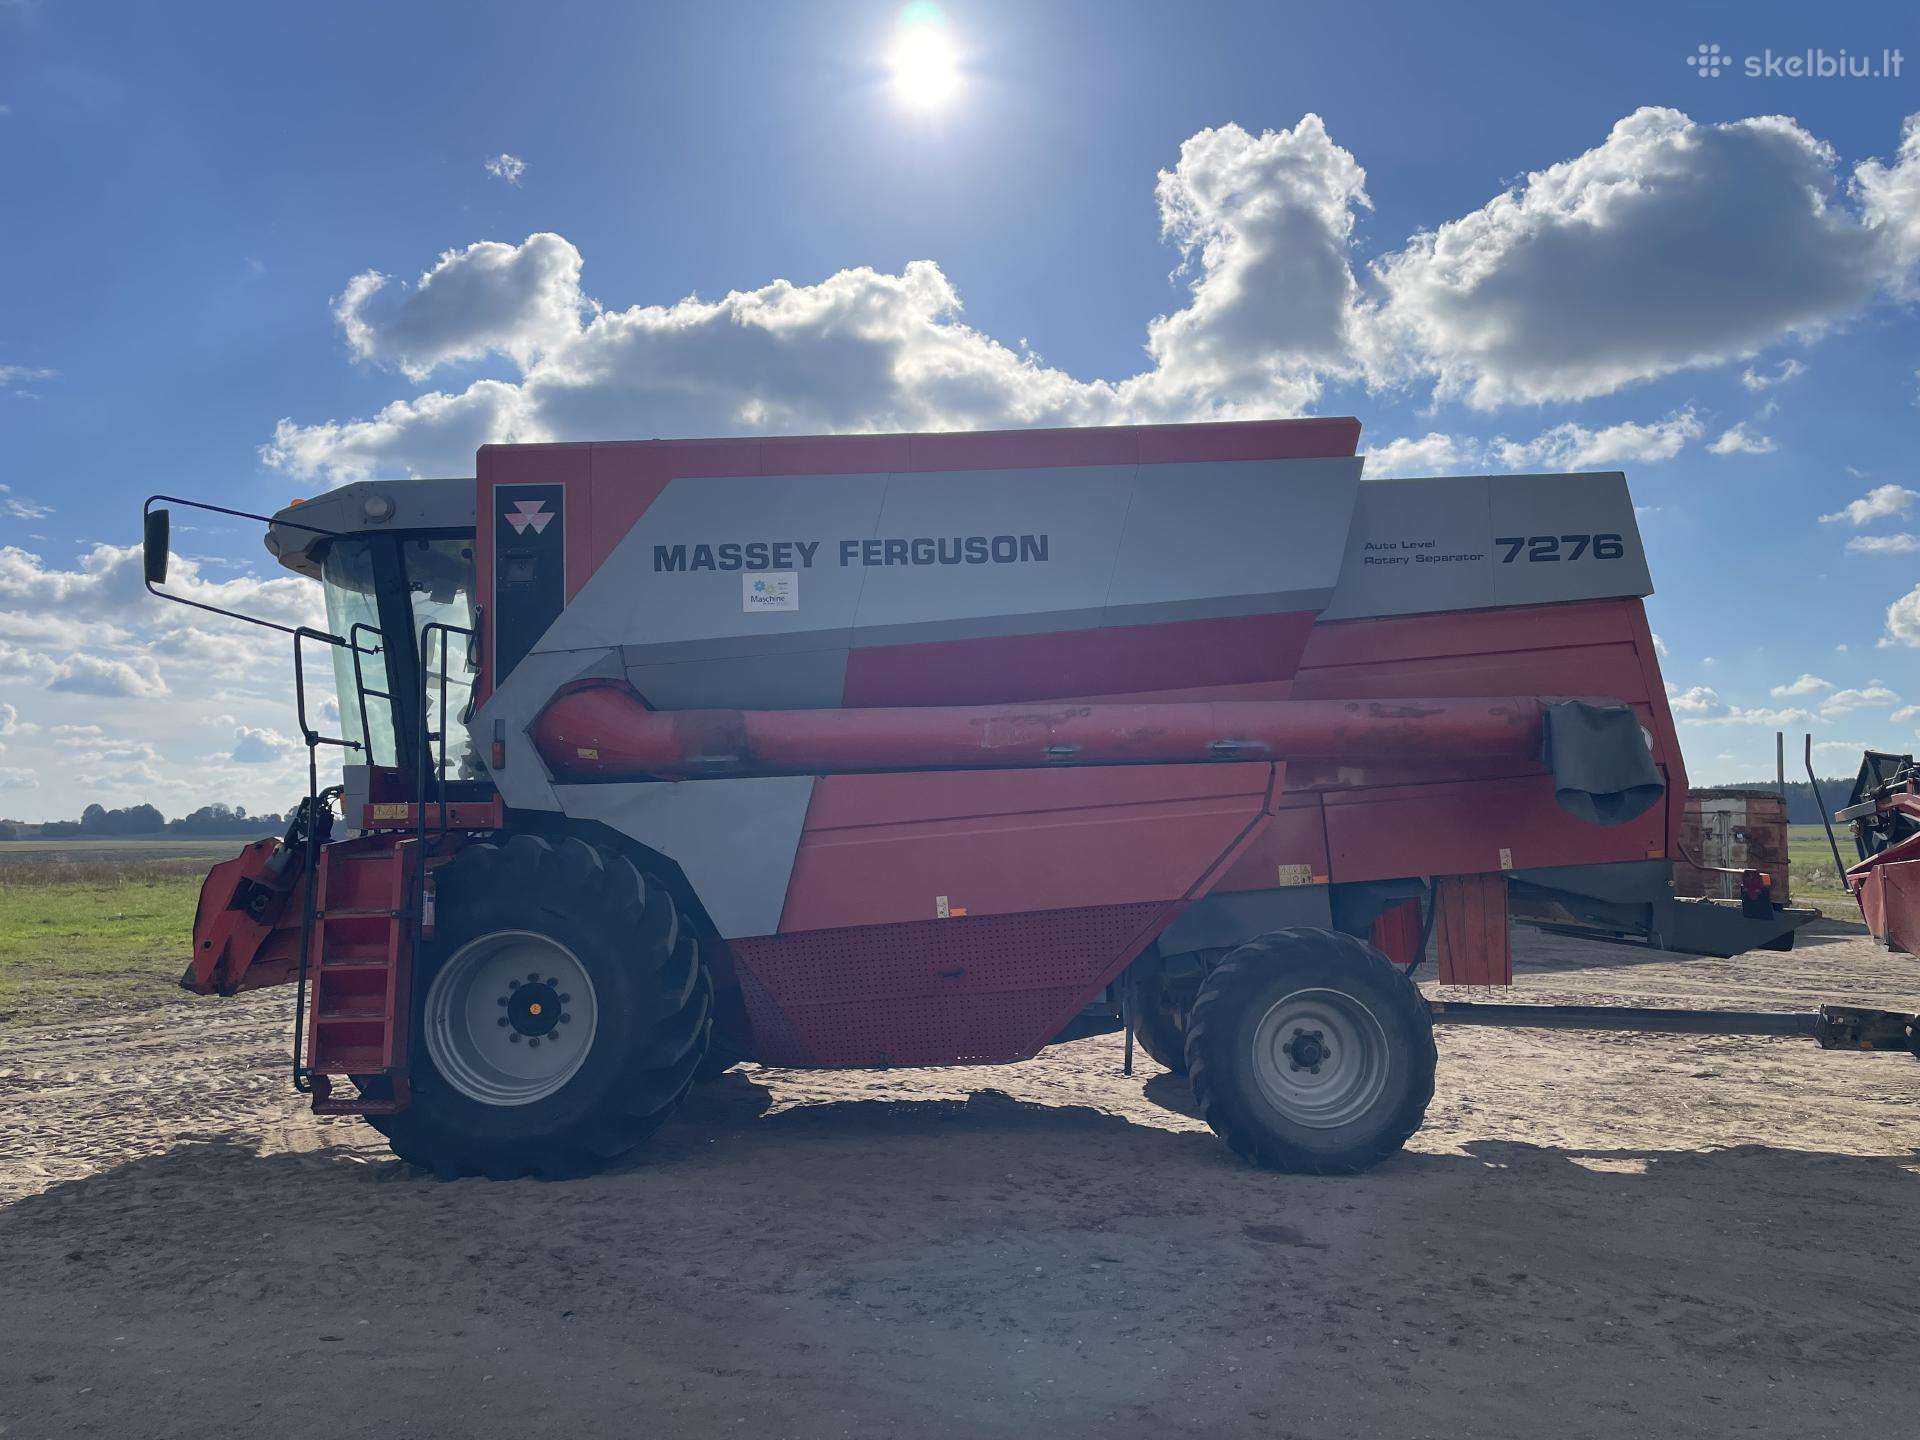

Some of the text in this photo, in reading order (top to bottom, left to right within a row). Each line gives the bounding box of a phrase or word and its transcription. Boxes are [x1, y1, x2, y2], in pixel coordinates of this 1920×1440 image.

[1364, 539, 1435, 551] Auto Level
[1495, 533, 1624, 563] 7276
[653, 534, 1049, 572] MASSEY FERGUSON
[1364, 552, 1485, 567] Rotary Separator
[750, 595, 785, 603] Maschine
